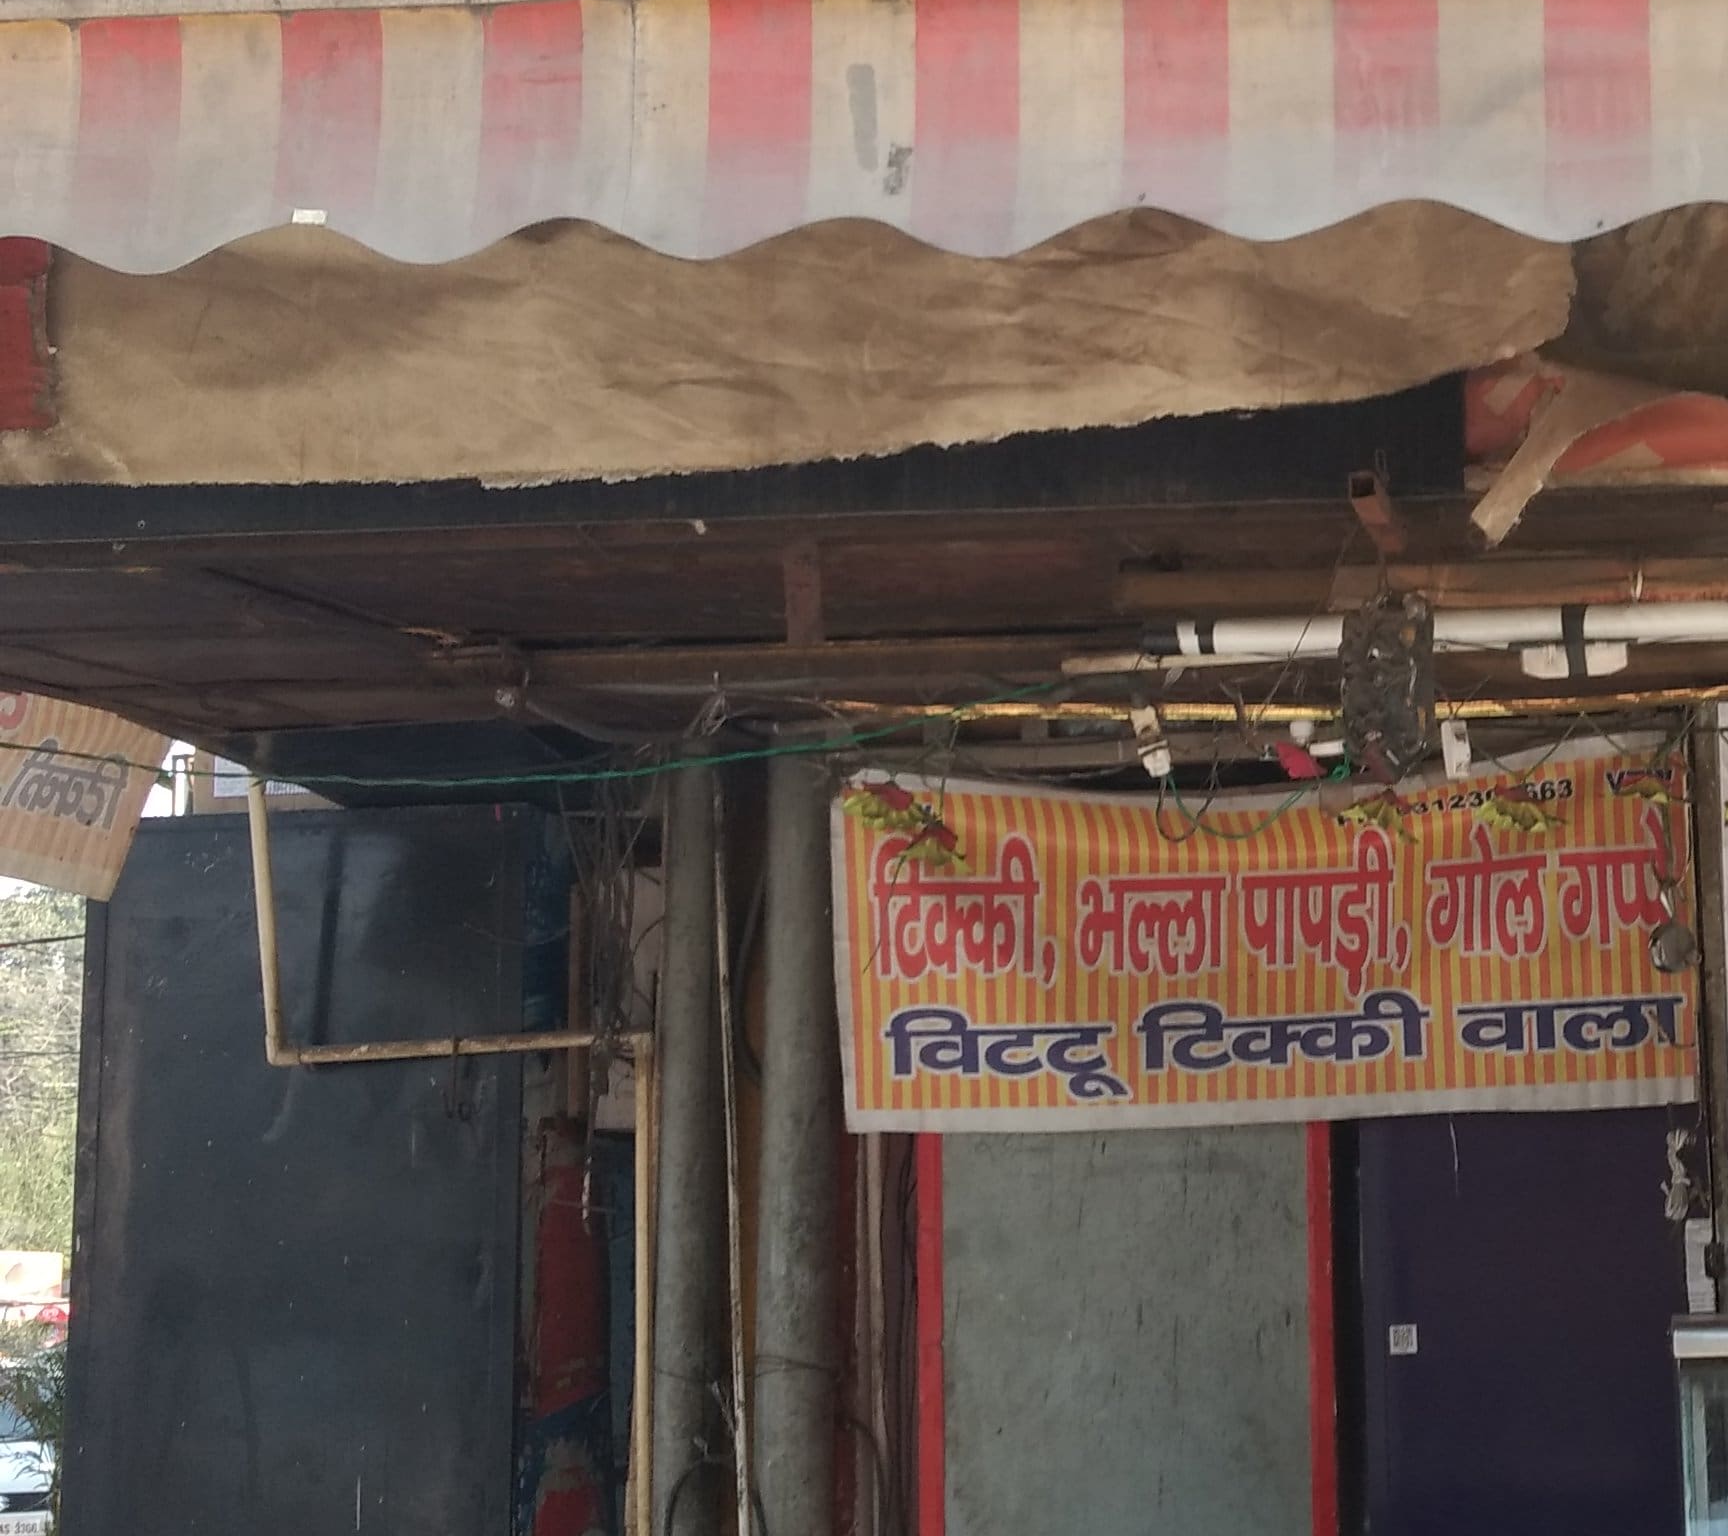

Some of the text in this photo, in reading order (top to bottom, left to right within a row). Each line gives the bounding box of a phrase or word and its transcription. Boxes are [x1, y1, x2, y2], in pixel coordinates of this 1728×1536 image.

[1426, 824, 1552, 959] गोल
[1138, 990, 1430, 1073] टिक्की
[1457, 995, 1687, 1053] वाला
